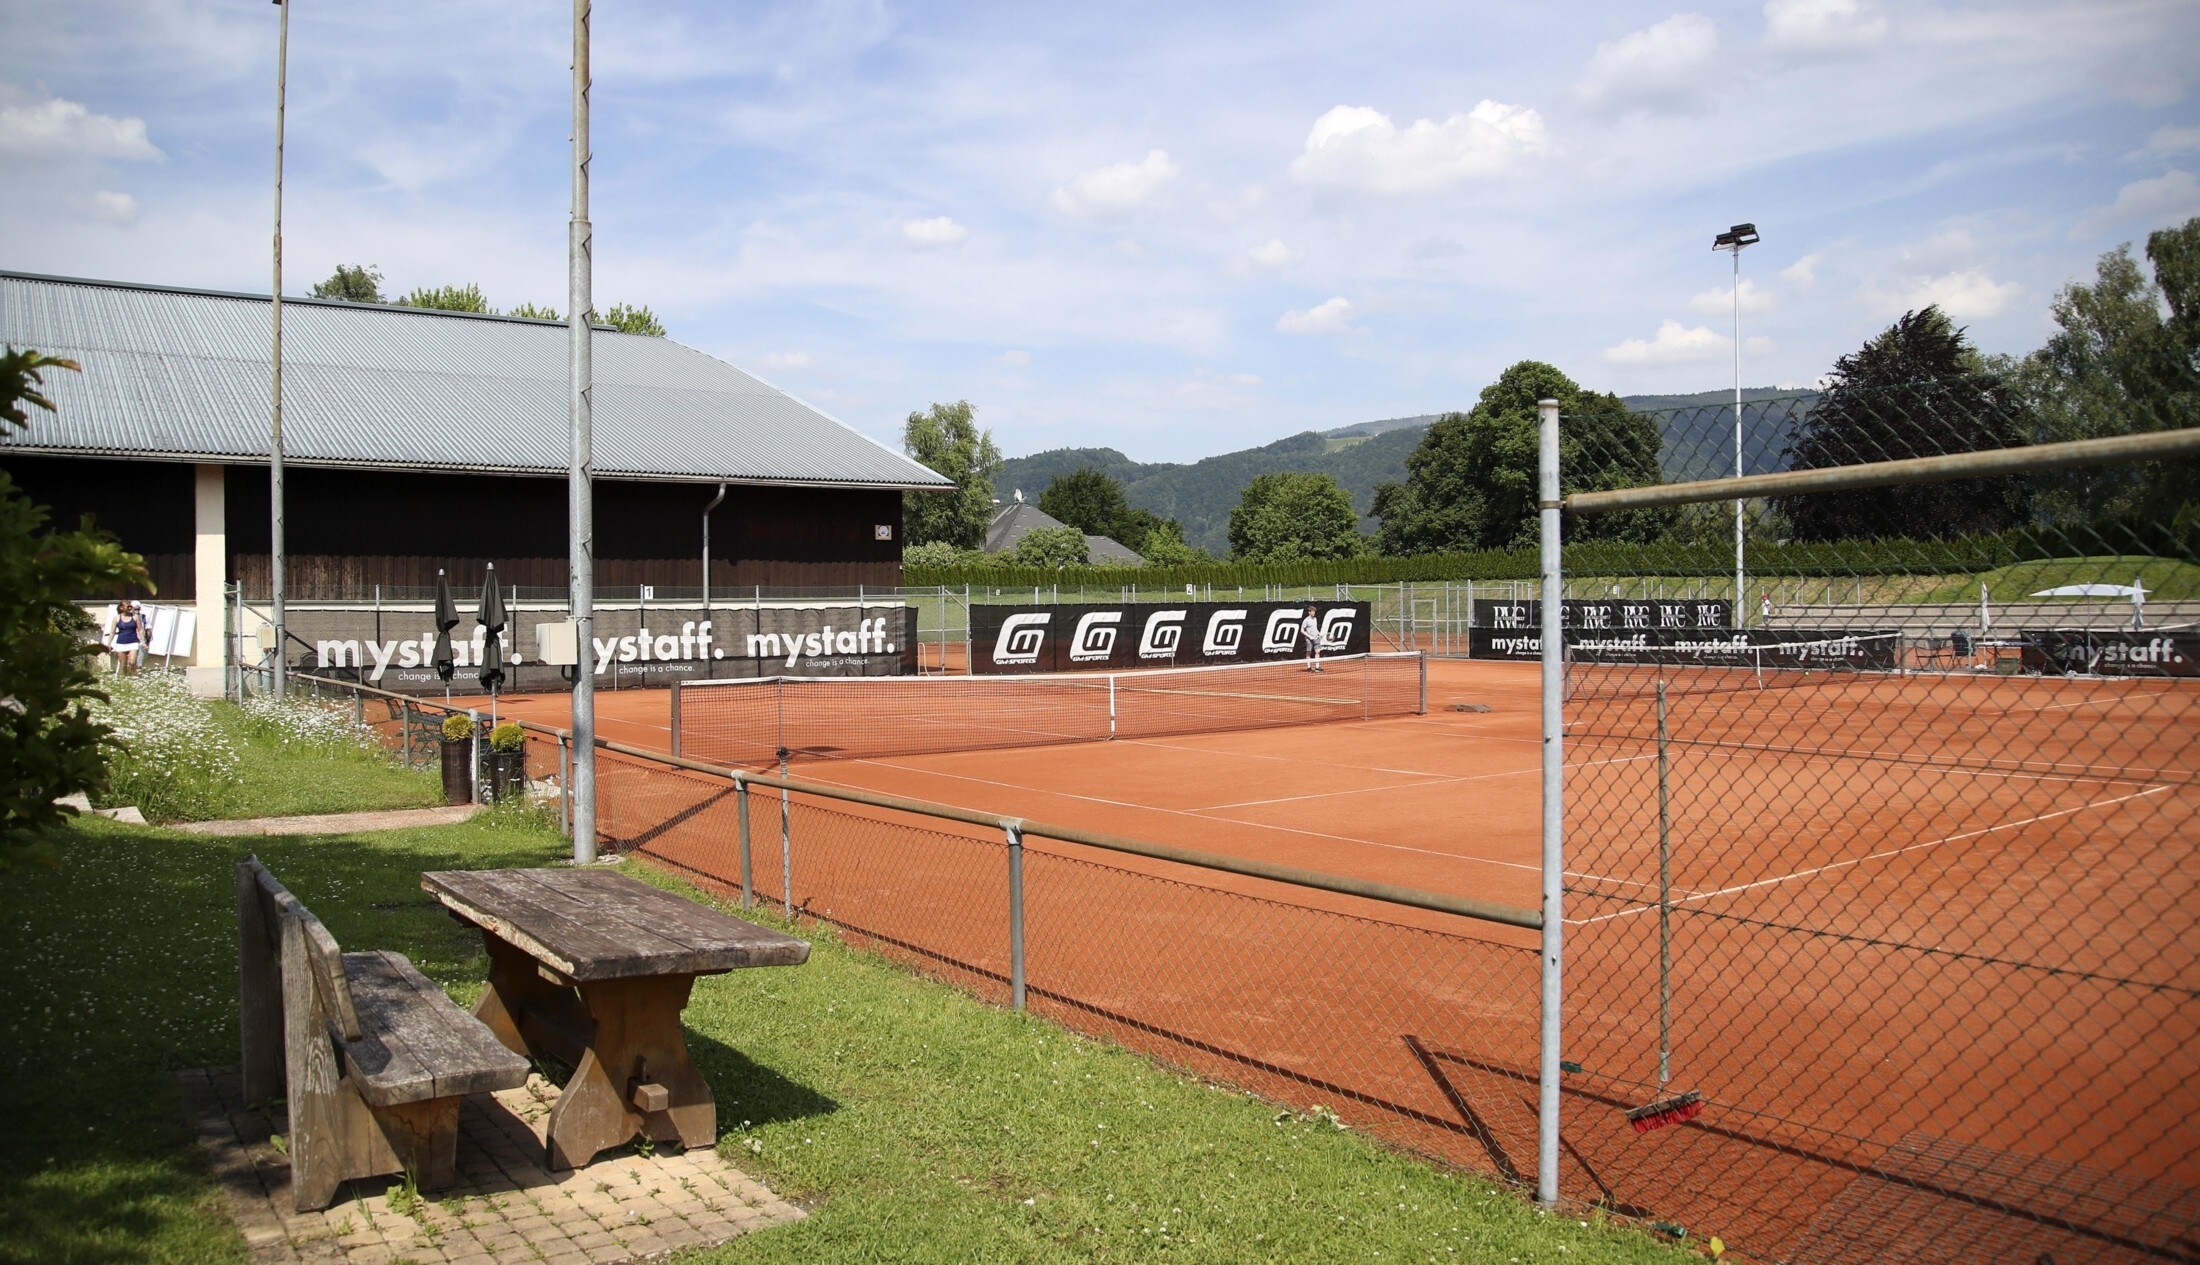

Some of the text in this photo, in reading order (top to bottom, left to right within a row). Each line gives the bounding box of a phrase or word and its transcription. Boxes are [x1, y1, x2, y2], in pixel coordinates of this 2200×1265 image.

[317, 623, 521, 681] mystaf.
[592, 620, 725, 675] ystaff.
[746, 617, 895, 668] mystaff.
[1491, 636, 1543, 655] mysta
[619, 664, 648, 675] change
[650, 664, 656, 672] is
[665, 663, 695, 672] chance.
[805, 659, 830, 668] change
[845, 656, 870, 666] chance.
[398, 671, 431, 682] change
[452, 670, 479, 680] chanc
